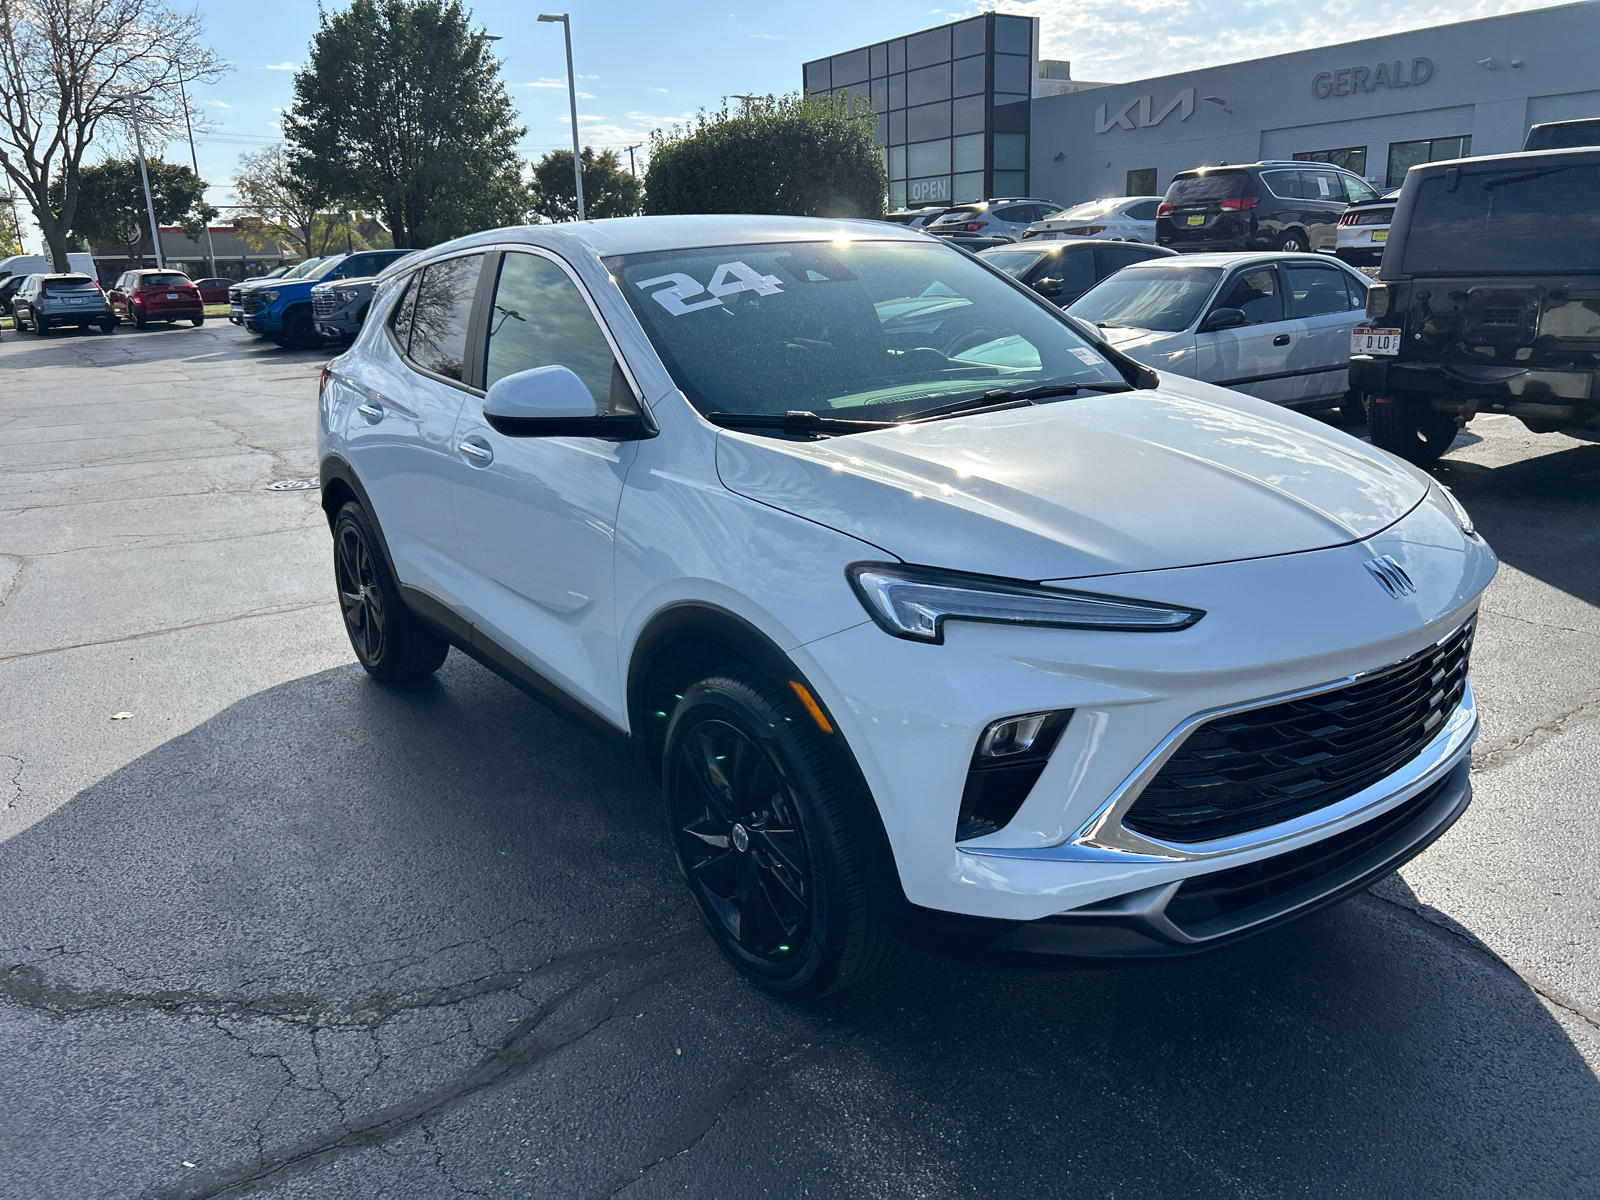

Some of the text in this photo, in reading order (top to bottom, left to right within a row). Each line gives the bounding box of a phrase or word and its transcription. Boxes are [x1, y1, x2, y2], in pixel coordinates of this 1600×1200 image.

[1311, 56, 1434, 100] GERALD
[1094, 87, 1195, 134] KIA
[912, 180, 946, 200] OPEN
[635, 261, 785, 316] 24
[1366, 335, 1373, 349] D
